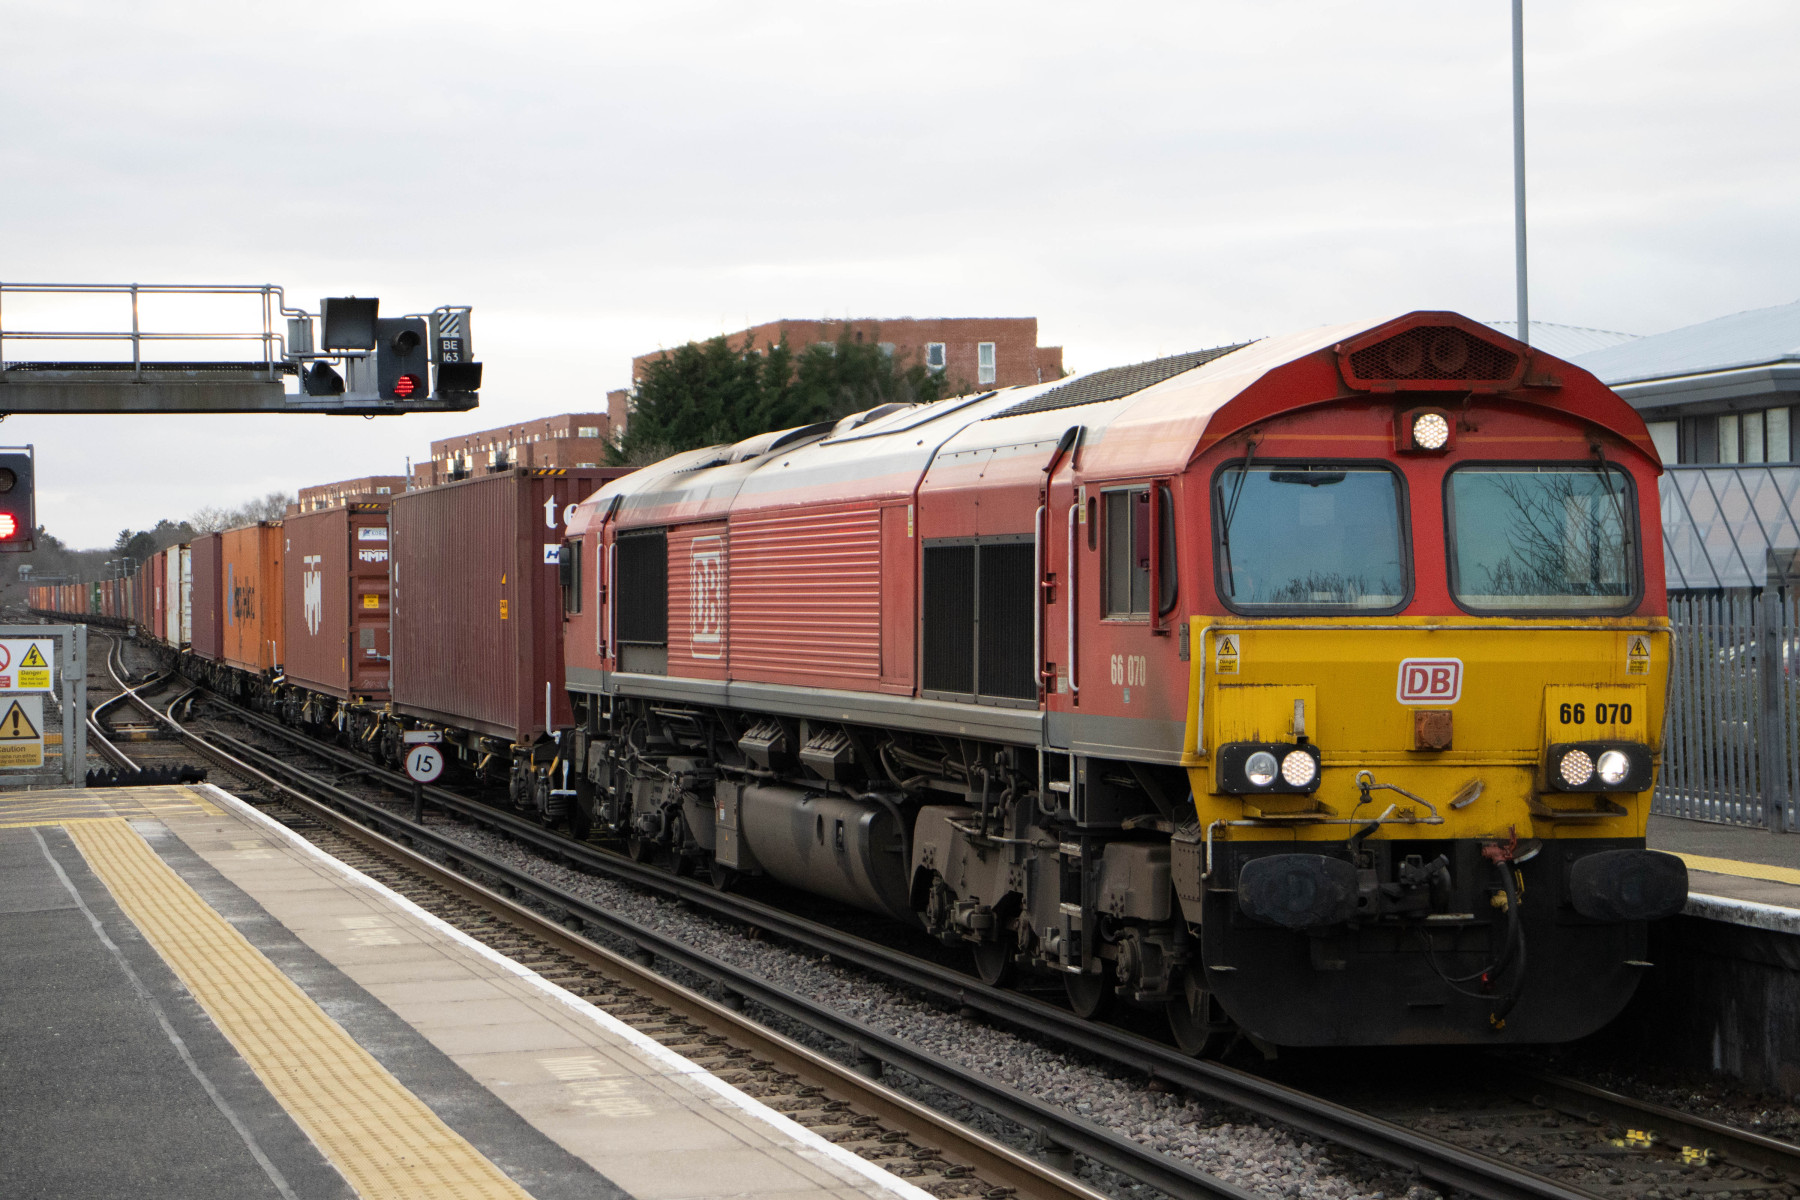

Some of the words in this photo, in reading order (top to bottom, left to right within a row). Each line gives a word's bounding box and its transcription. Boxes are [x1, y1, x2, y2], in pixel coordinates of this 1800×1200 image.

[443, 341, 458, 350] BE
[443, 352, 459, 362] 163
[359, 549, 388, 562] HMM
[1111, 654, 1124, 686] 66
[1127, 655, 1146, 687] 070
[1405, 666, 1453, 696] DB
[1560, 703, 1585, 725] 66
[1595, 703, 1632, 725] 070
[416, 754, 434, 772] 15
